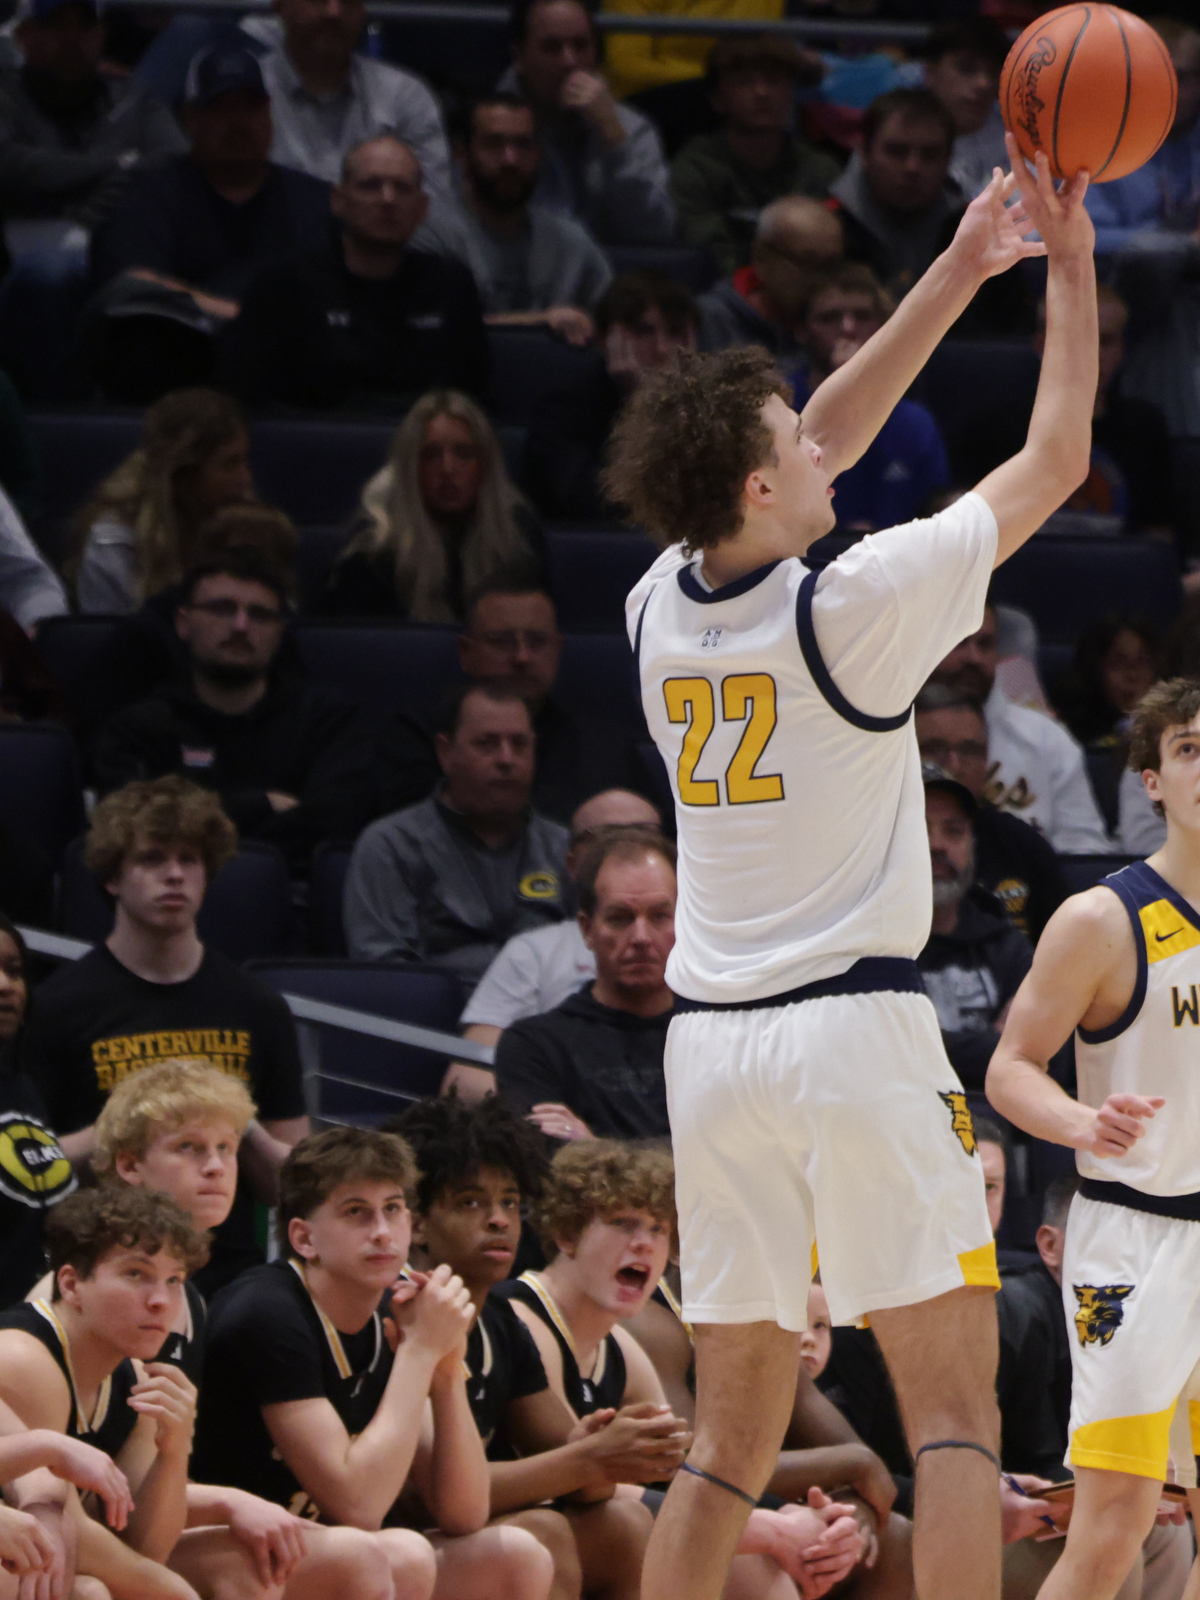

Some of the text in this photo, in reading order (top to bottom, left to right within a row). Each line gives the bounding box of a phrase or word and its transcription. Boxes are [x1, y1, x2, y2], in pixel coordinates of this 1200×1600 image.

[1016, 36, 1057, 147] Rawlings
[662, 672, 785, 806] 22
[91, 1029, 251, 1066] CENTERVILLE
